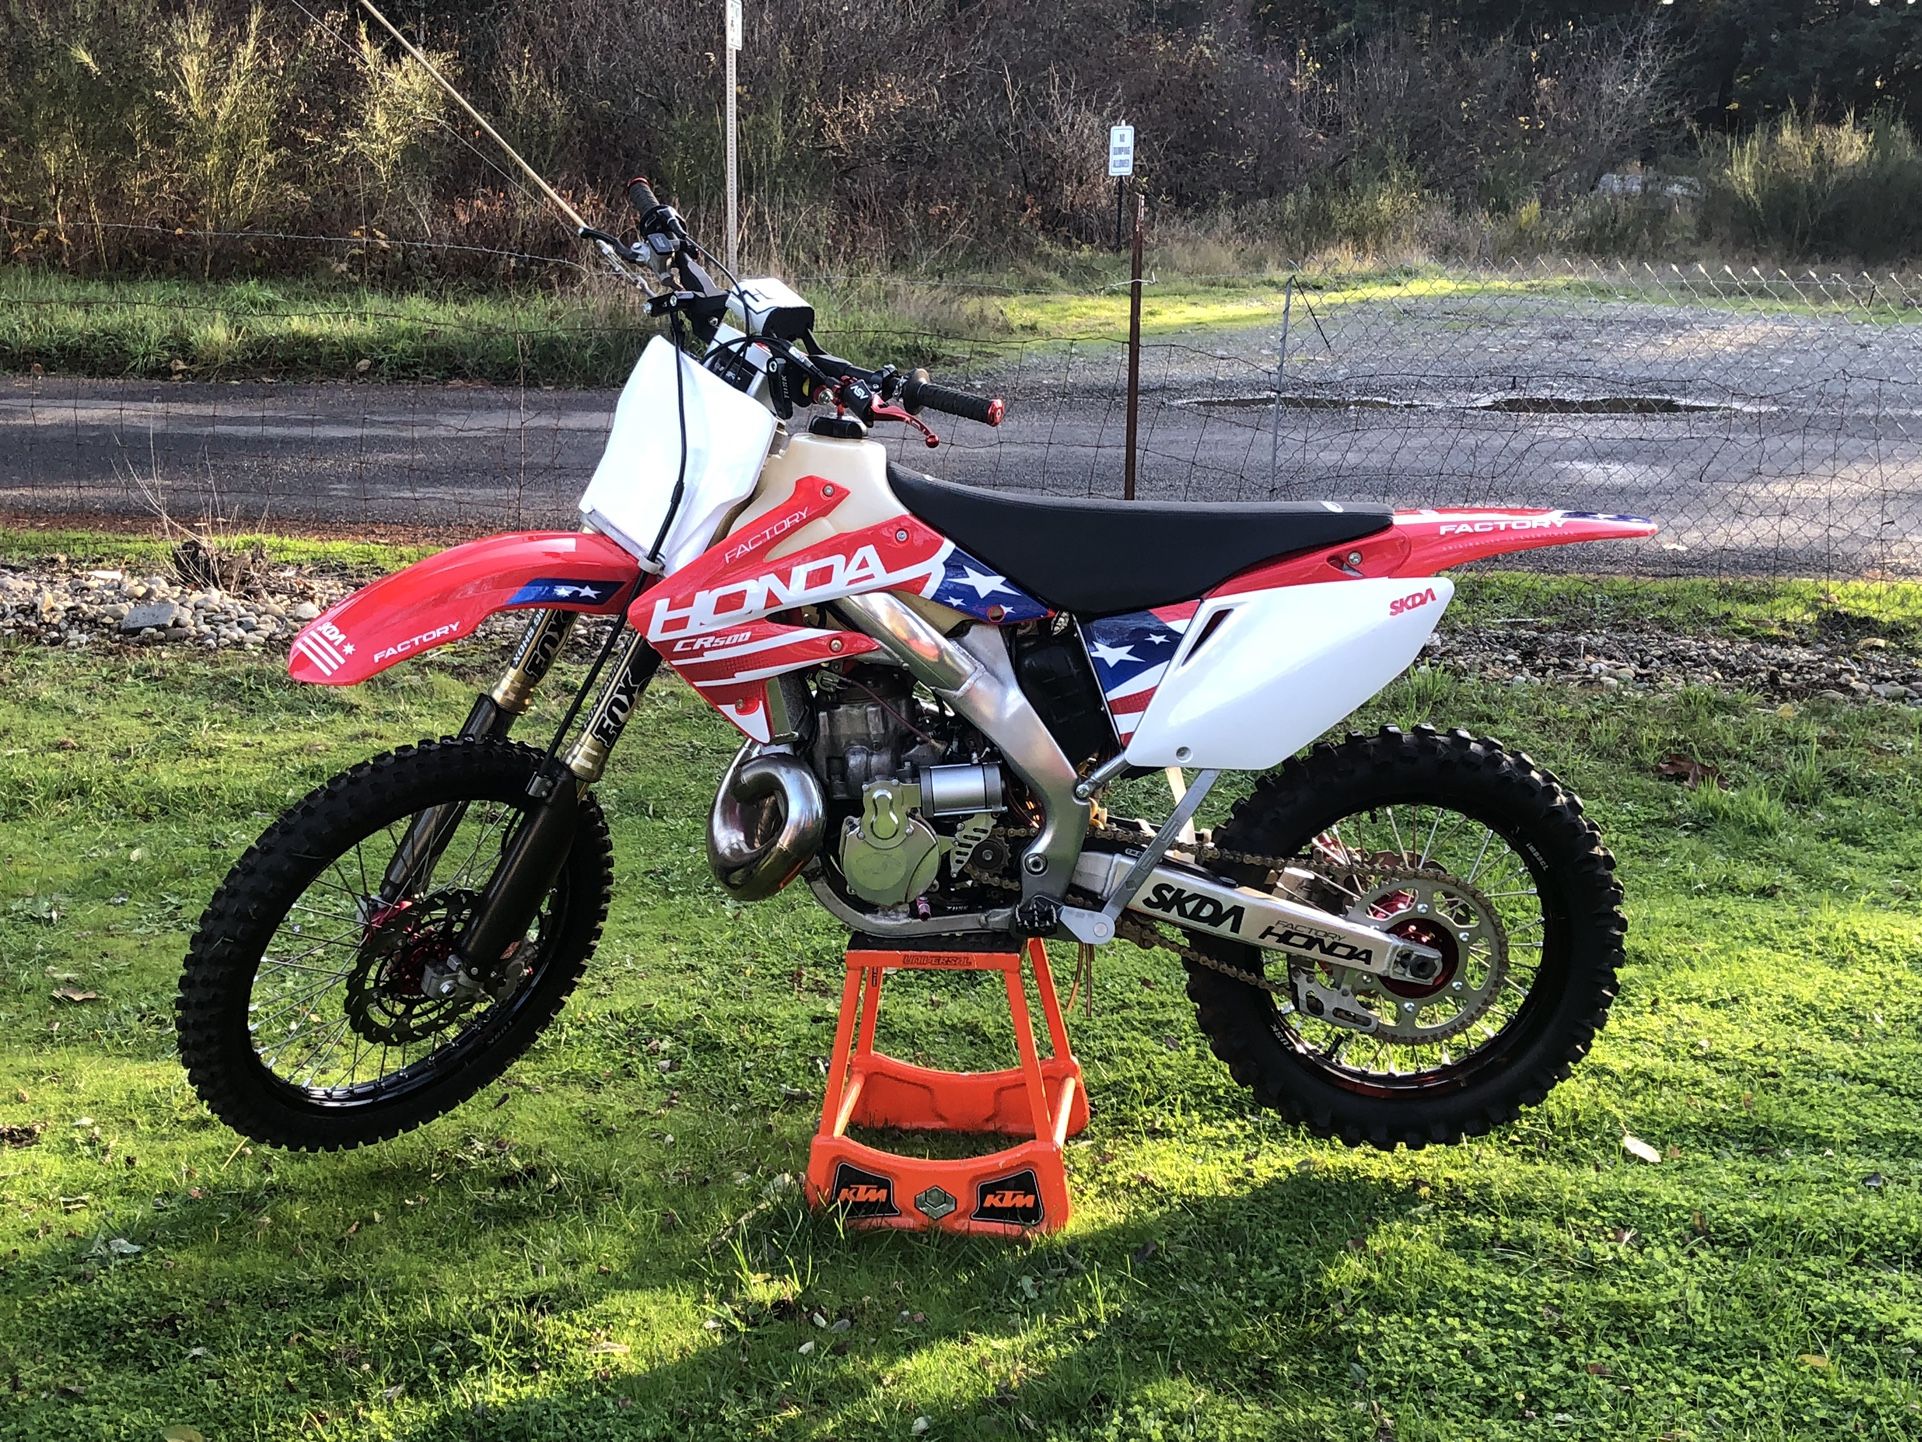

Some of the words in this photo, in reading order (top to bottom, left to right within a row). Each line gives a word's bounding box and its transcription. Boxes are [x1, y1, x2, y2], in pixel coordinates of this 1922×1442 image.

[724, 507, 809, 564] FACTORY
[1439, 519, 1568, 536] FACTORY
[647, 544, 888, 642] HONDA
[1389, 587, 1437, 616] SKDA
[373, 621, 460, 663] FACTORY
[673, 631, 752, 653] CR500
[591, 665, 642, 749] FOX
[1142, 882, 1246, 934] SKDA
[1275, 920, 1346, 941] FACTORY
[1258, 925, 1373, 966] HONDA
[1270, 1023, 1295, 1052] TUSK
[839, 1184, 888, 1202] KTM
[983, 1191, 1036, 1208] KTM
